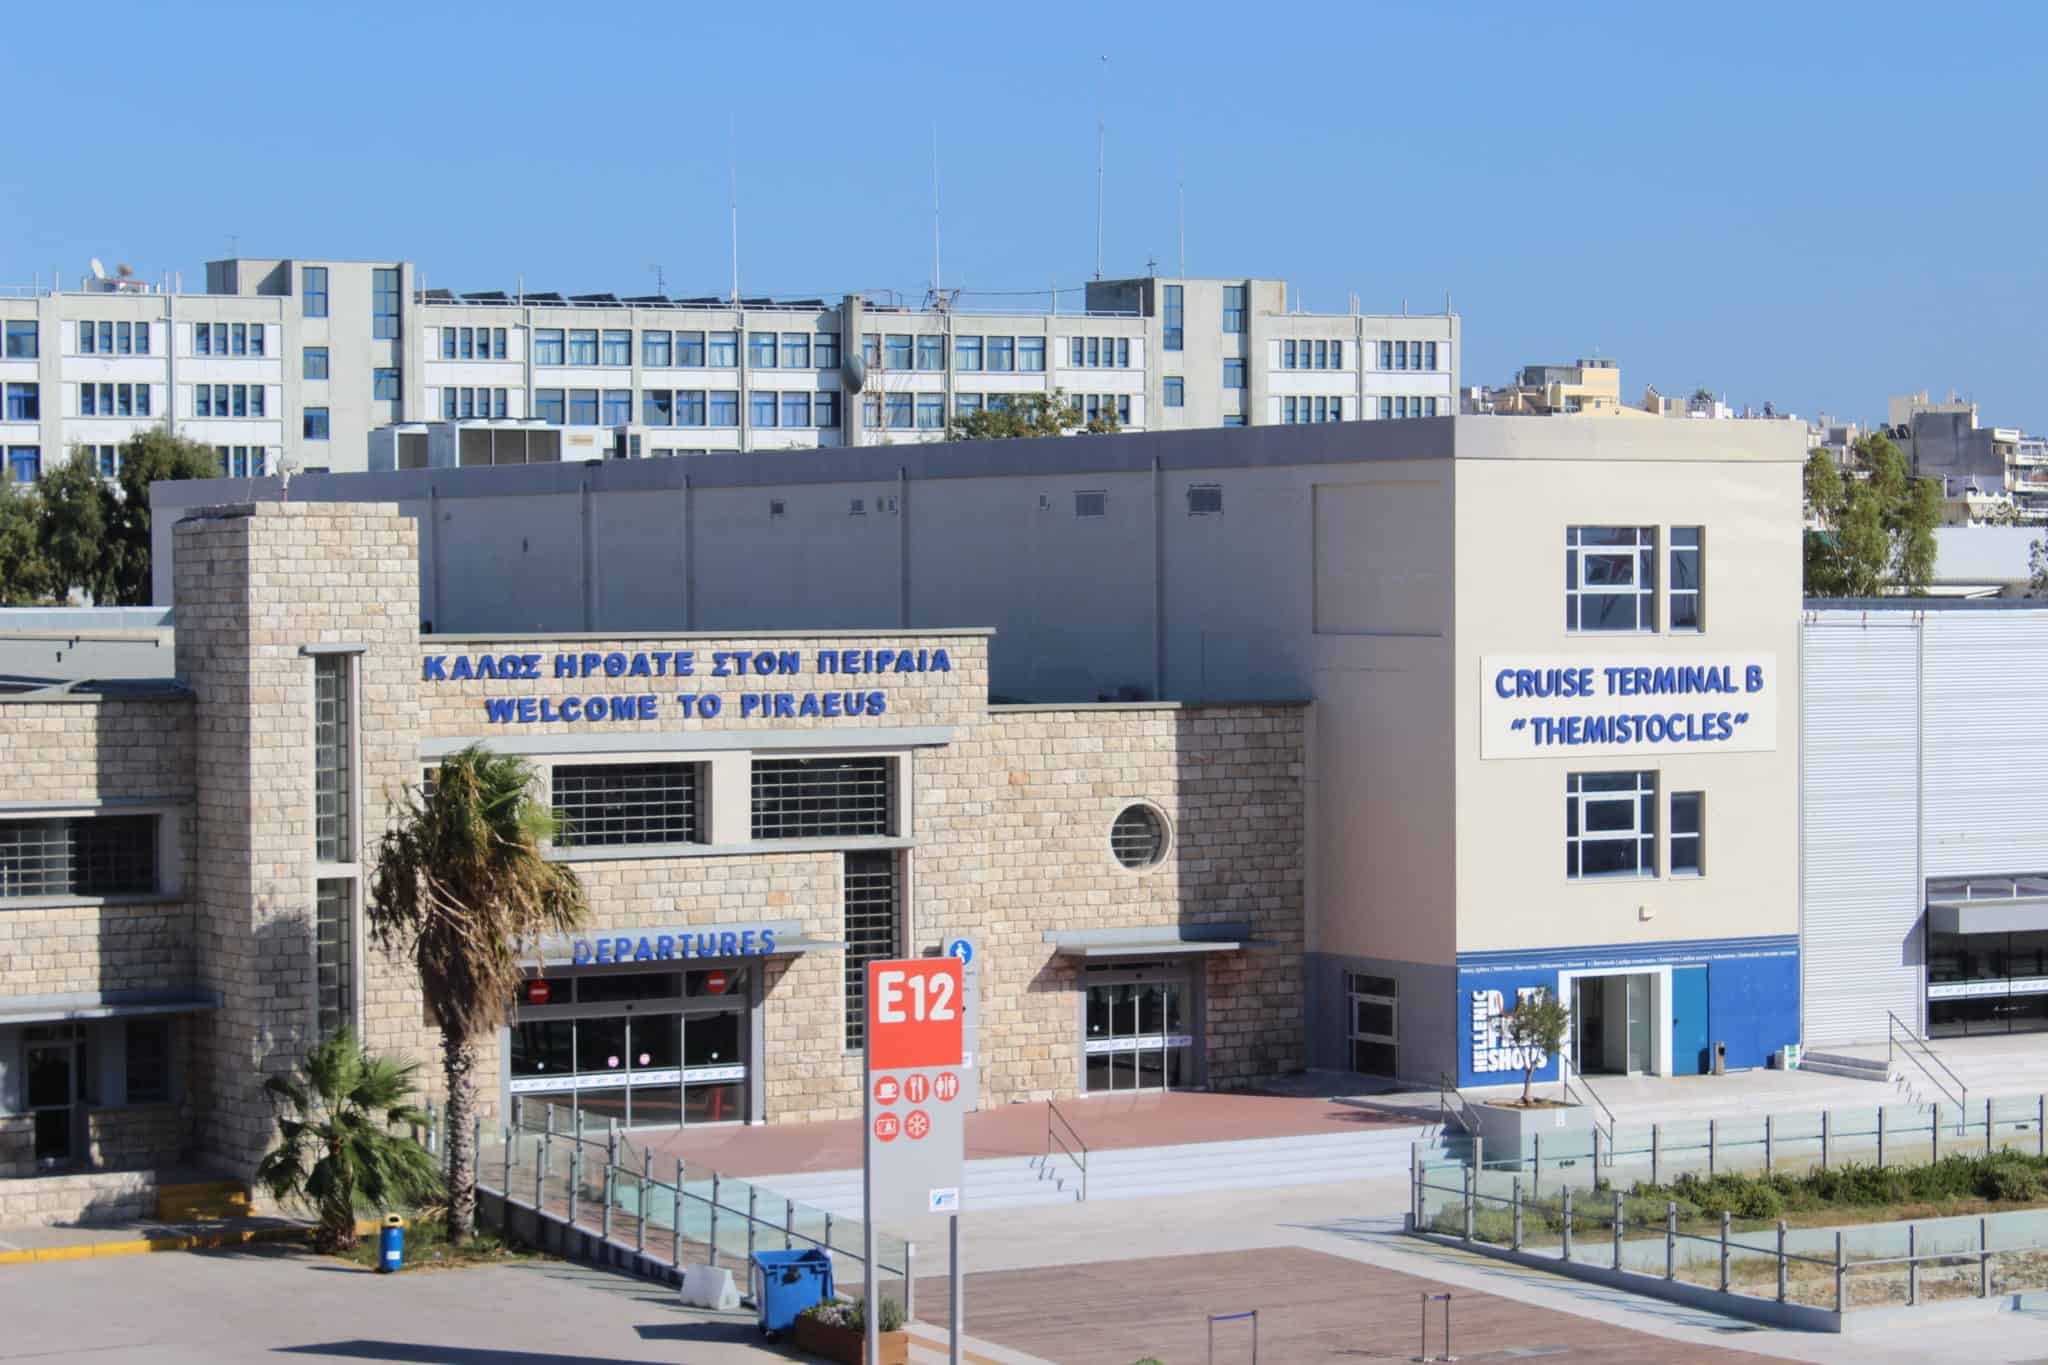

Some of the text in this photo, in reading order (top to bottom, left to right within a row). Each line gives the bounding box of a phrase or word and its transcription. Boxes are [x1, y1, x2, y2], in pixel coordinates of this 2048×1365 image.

[422, 649, 951, 681] ΚΑΛΩΣ ΗΡΘΑΤΕ ΣΤΟΝ ΠΕΙΡΑΙΑ
[1495, 665, 1764, 698] CRUISE TERMINAL B
[485, 691, 886, 724] WELCOME TO PIRAEUS
[573, 929, 776, 964] DEPARTURES
[878, 970, 955, 1023] E12
[1488, 987, 1546, 1017] DTY
[1473, 990, 1488, 1073] HELLENIC
[1488, 1016, 1546, 1049] FRE
